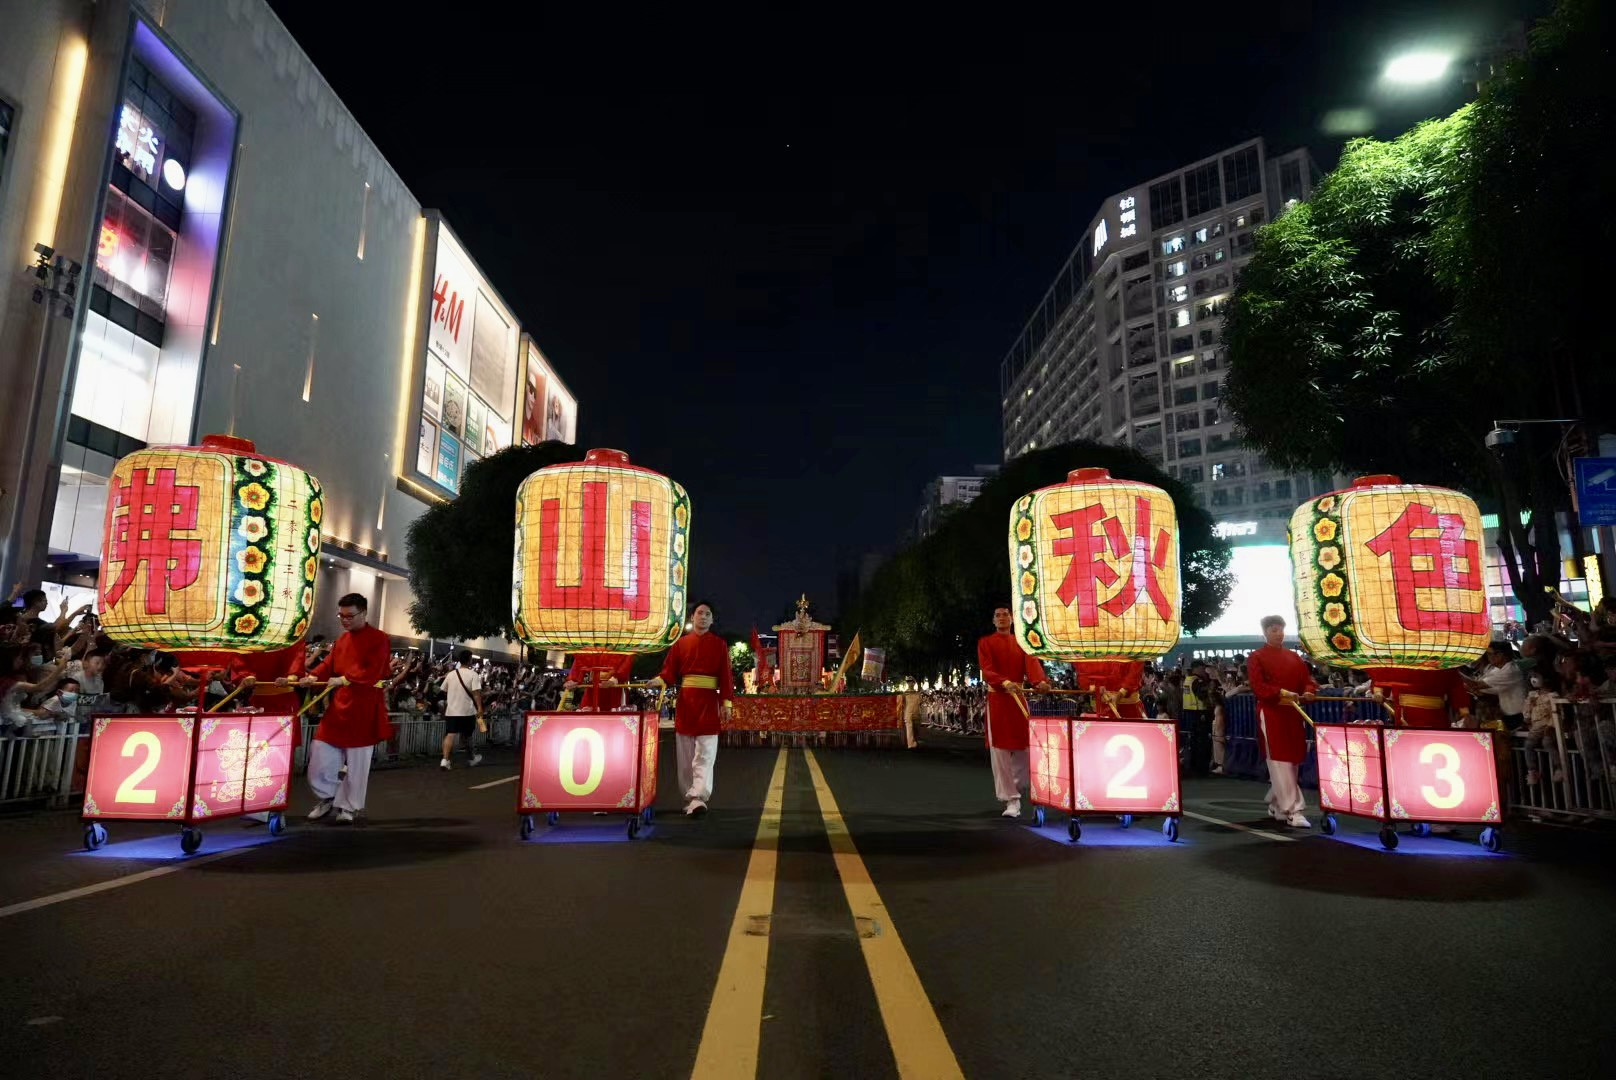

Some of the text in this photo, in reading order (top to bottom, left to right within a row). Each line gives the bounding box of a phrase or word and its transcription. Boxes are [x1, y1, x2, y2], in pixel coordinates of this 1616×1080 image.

[433, 273, 464, 344] H&M
[99, 468, 202, 615] 佛
[539, 481, 651, 621] 山
[1049, 496, 1172, 627] 秋
[1364, 502, 1490, 635] 色
[1193, 648, 1256, 659] STARBUC
[115, 731, 162, 804] 2
[559, 727, 605, 796] 0
[1104, 734, 1148, 799] 2
[1419, 743, 1465, 809] 3
